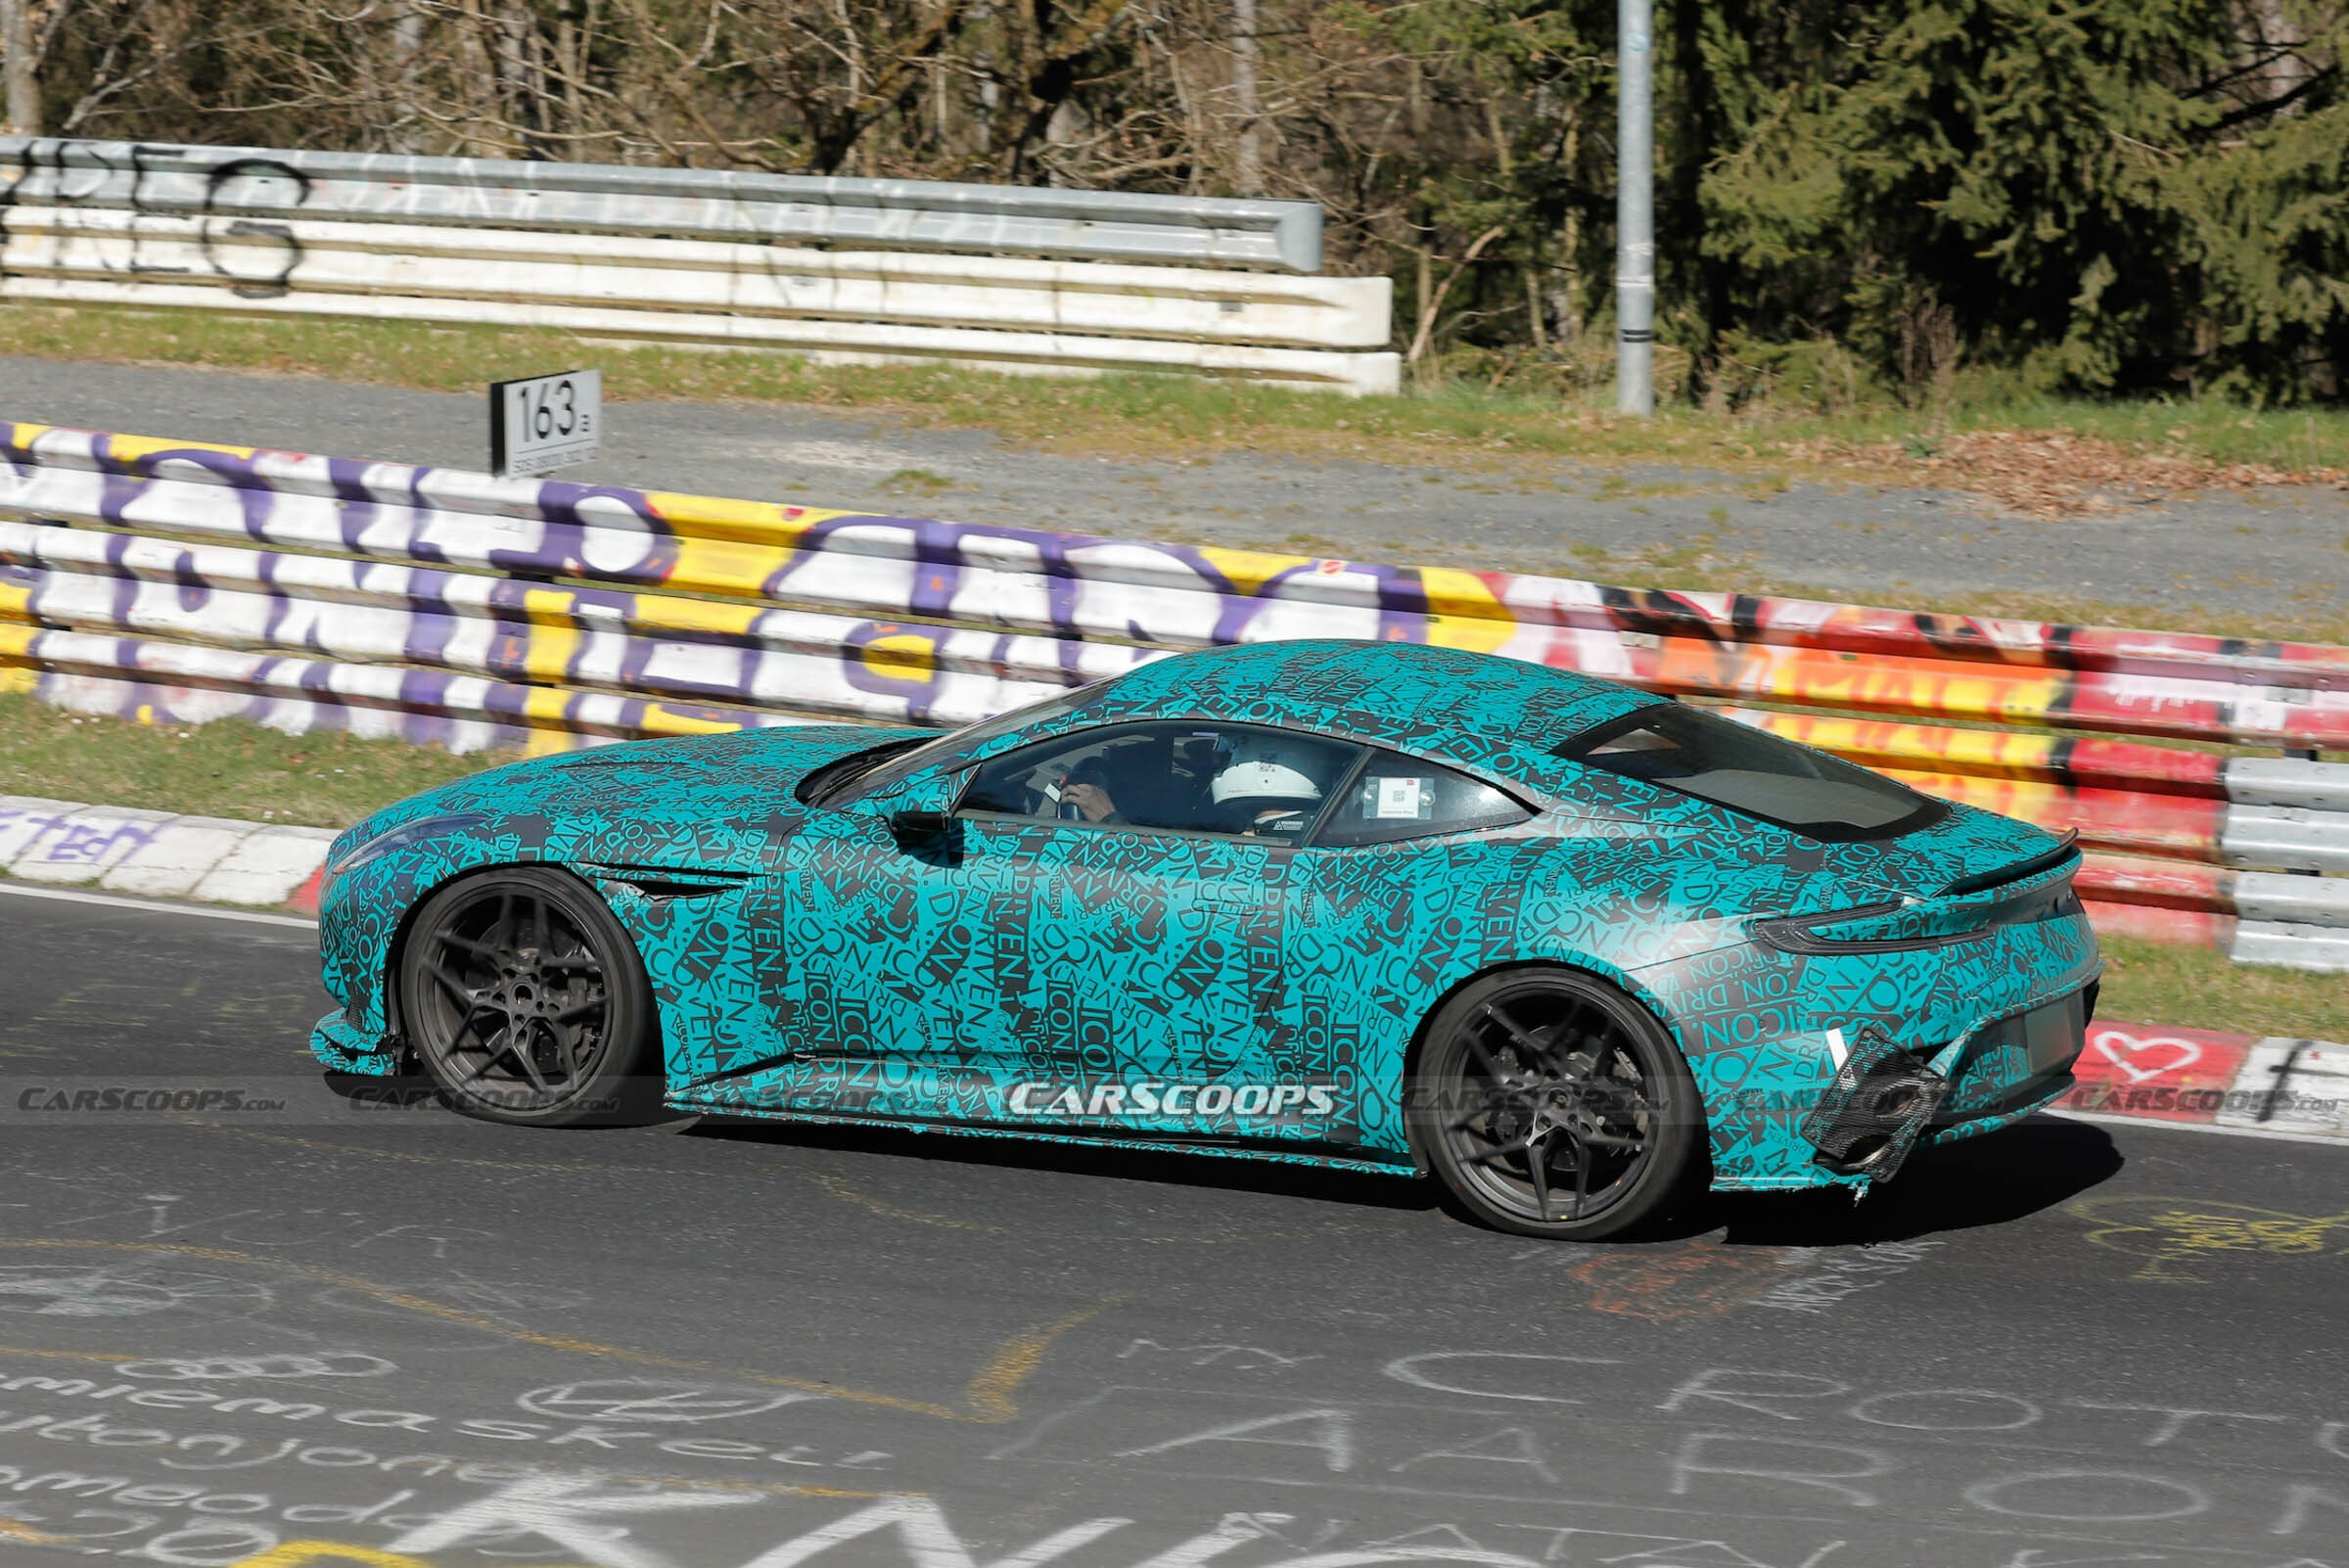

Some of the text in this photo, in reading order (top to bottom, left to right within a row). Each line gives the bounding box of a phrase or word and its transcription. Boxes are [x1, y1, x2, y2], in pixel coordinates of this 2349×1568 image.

[519, 380, 575, 442] 163
[808, 973, 833, 1048] ICON.
[1048, 981, 1073, 1053] ICON.
[1304, 996, 1328, 1077] ICON.
[1691, 1004, 1800, 1049] ICON.
